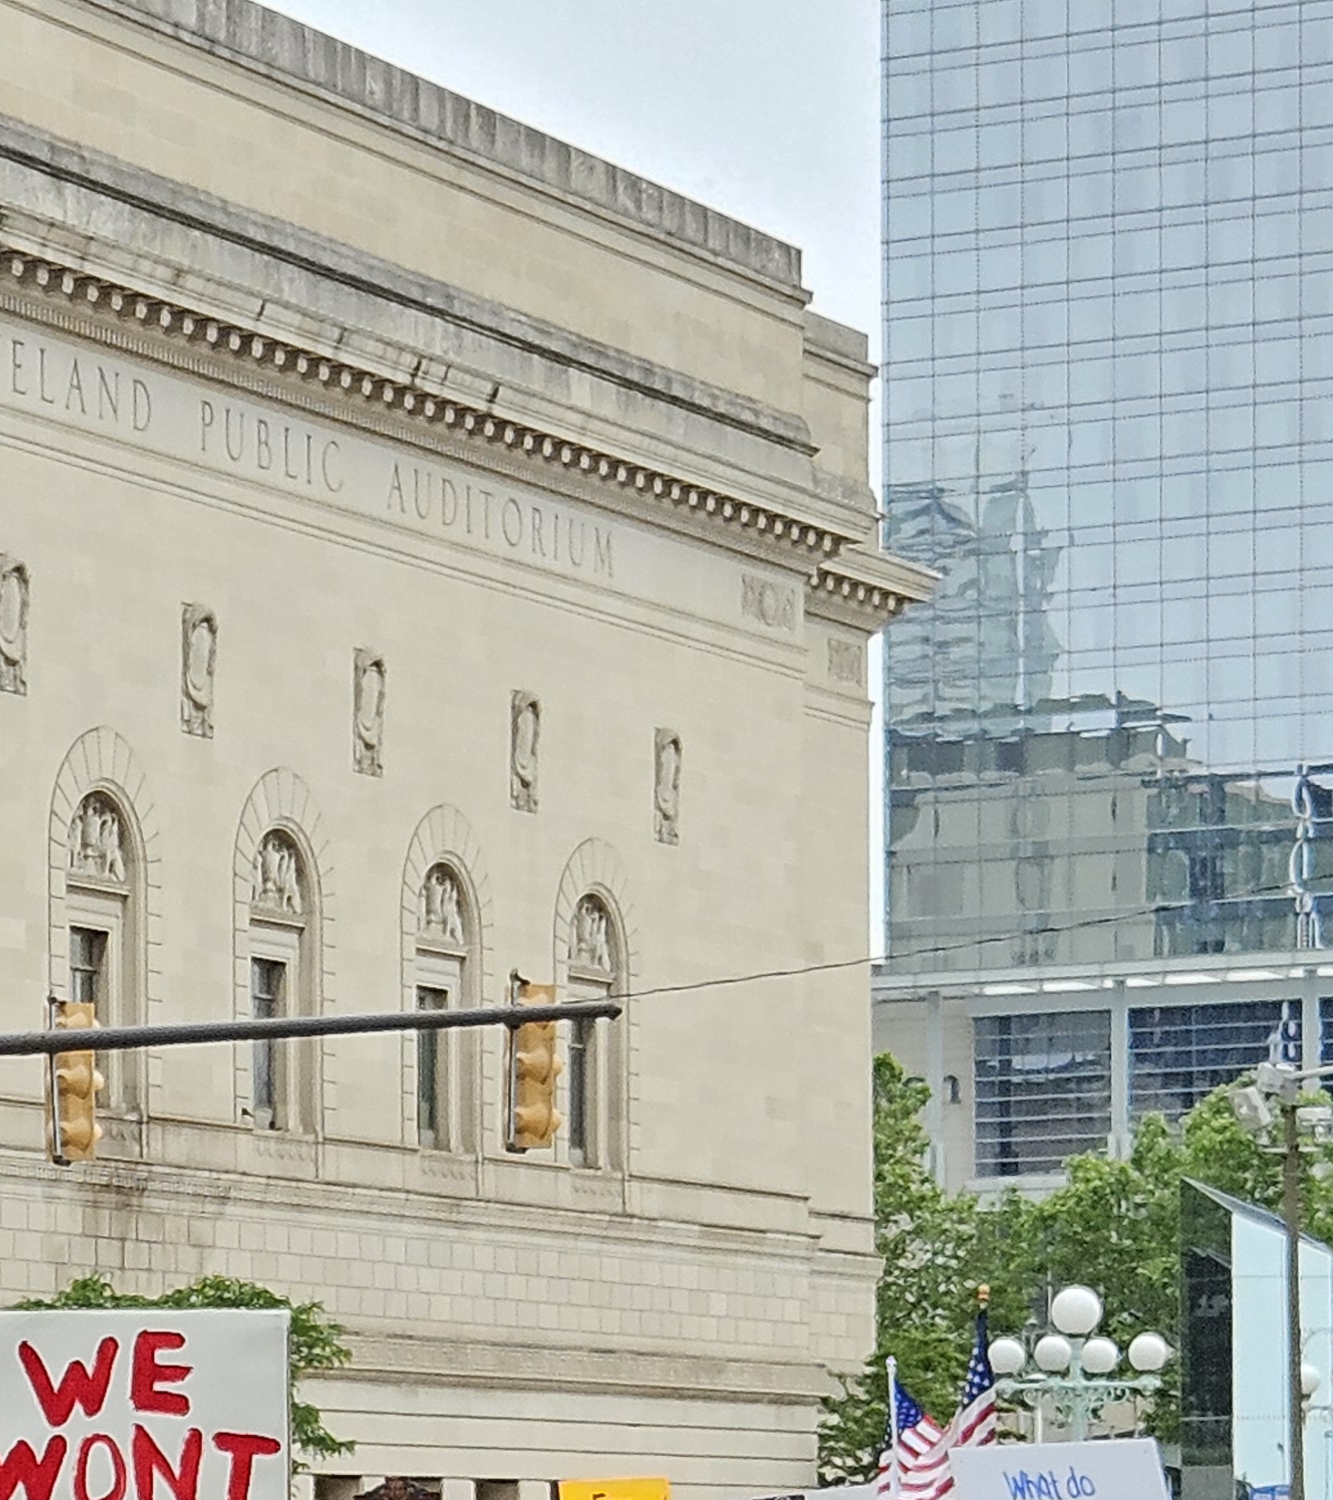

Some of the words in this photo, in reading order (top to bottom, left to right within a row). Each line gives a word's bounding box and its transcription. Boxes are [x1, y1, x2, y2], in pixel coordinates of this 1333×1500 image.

[199, 399, 344, 494] PUBLIC
[386, 461, 615, 579] AUDITORIUM
[17, 1328, 194, 1428] WE
